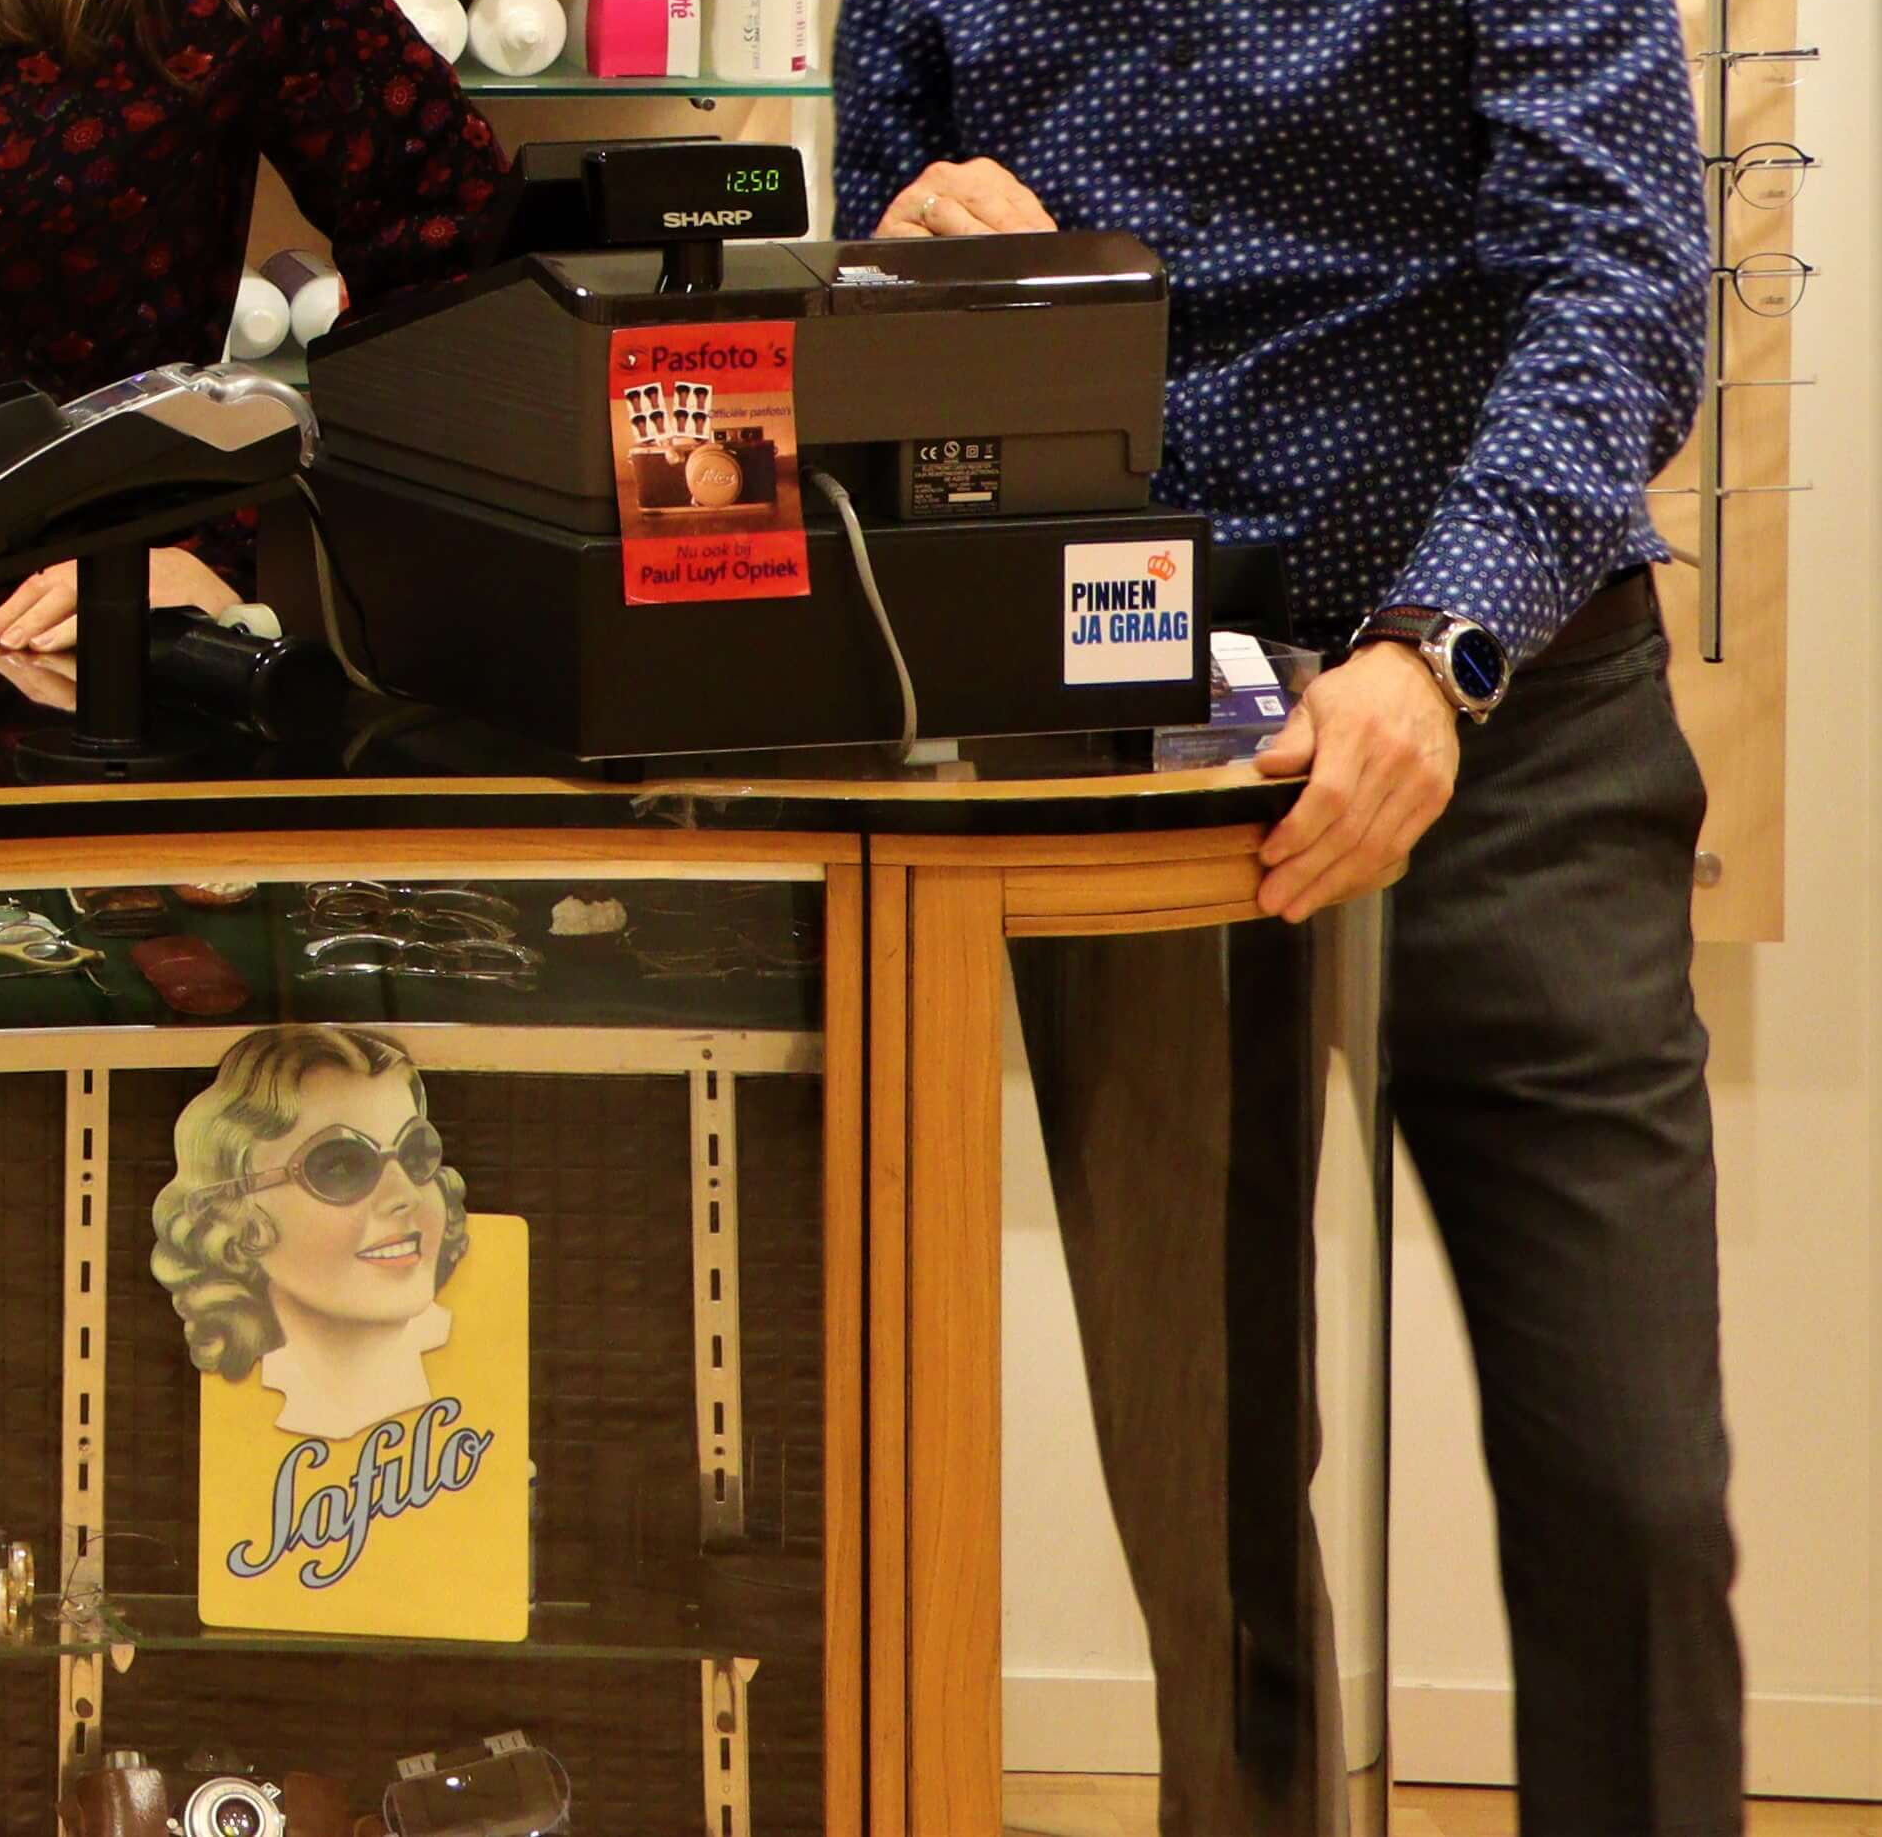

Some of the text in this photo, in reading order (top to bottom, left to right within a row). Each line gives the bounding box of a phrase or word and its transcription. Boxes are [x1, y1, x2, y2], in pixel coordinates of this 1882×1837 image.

[726, 169, 779, 193] 12.50
[663, 210, 753, 228] SHARP
[652, 341, 758, 373] Pasfoto
[677, 541, 752, 560] Nu ook bij
[641, 559, 798, 586] Paul Luyf Optiek
[1071, 579, 1157, 612] PINNEN
[1071, 611, 1189, 645] JA GRAAG
[226, 1396, 495, 1589] Safilo
